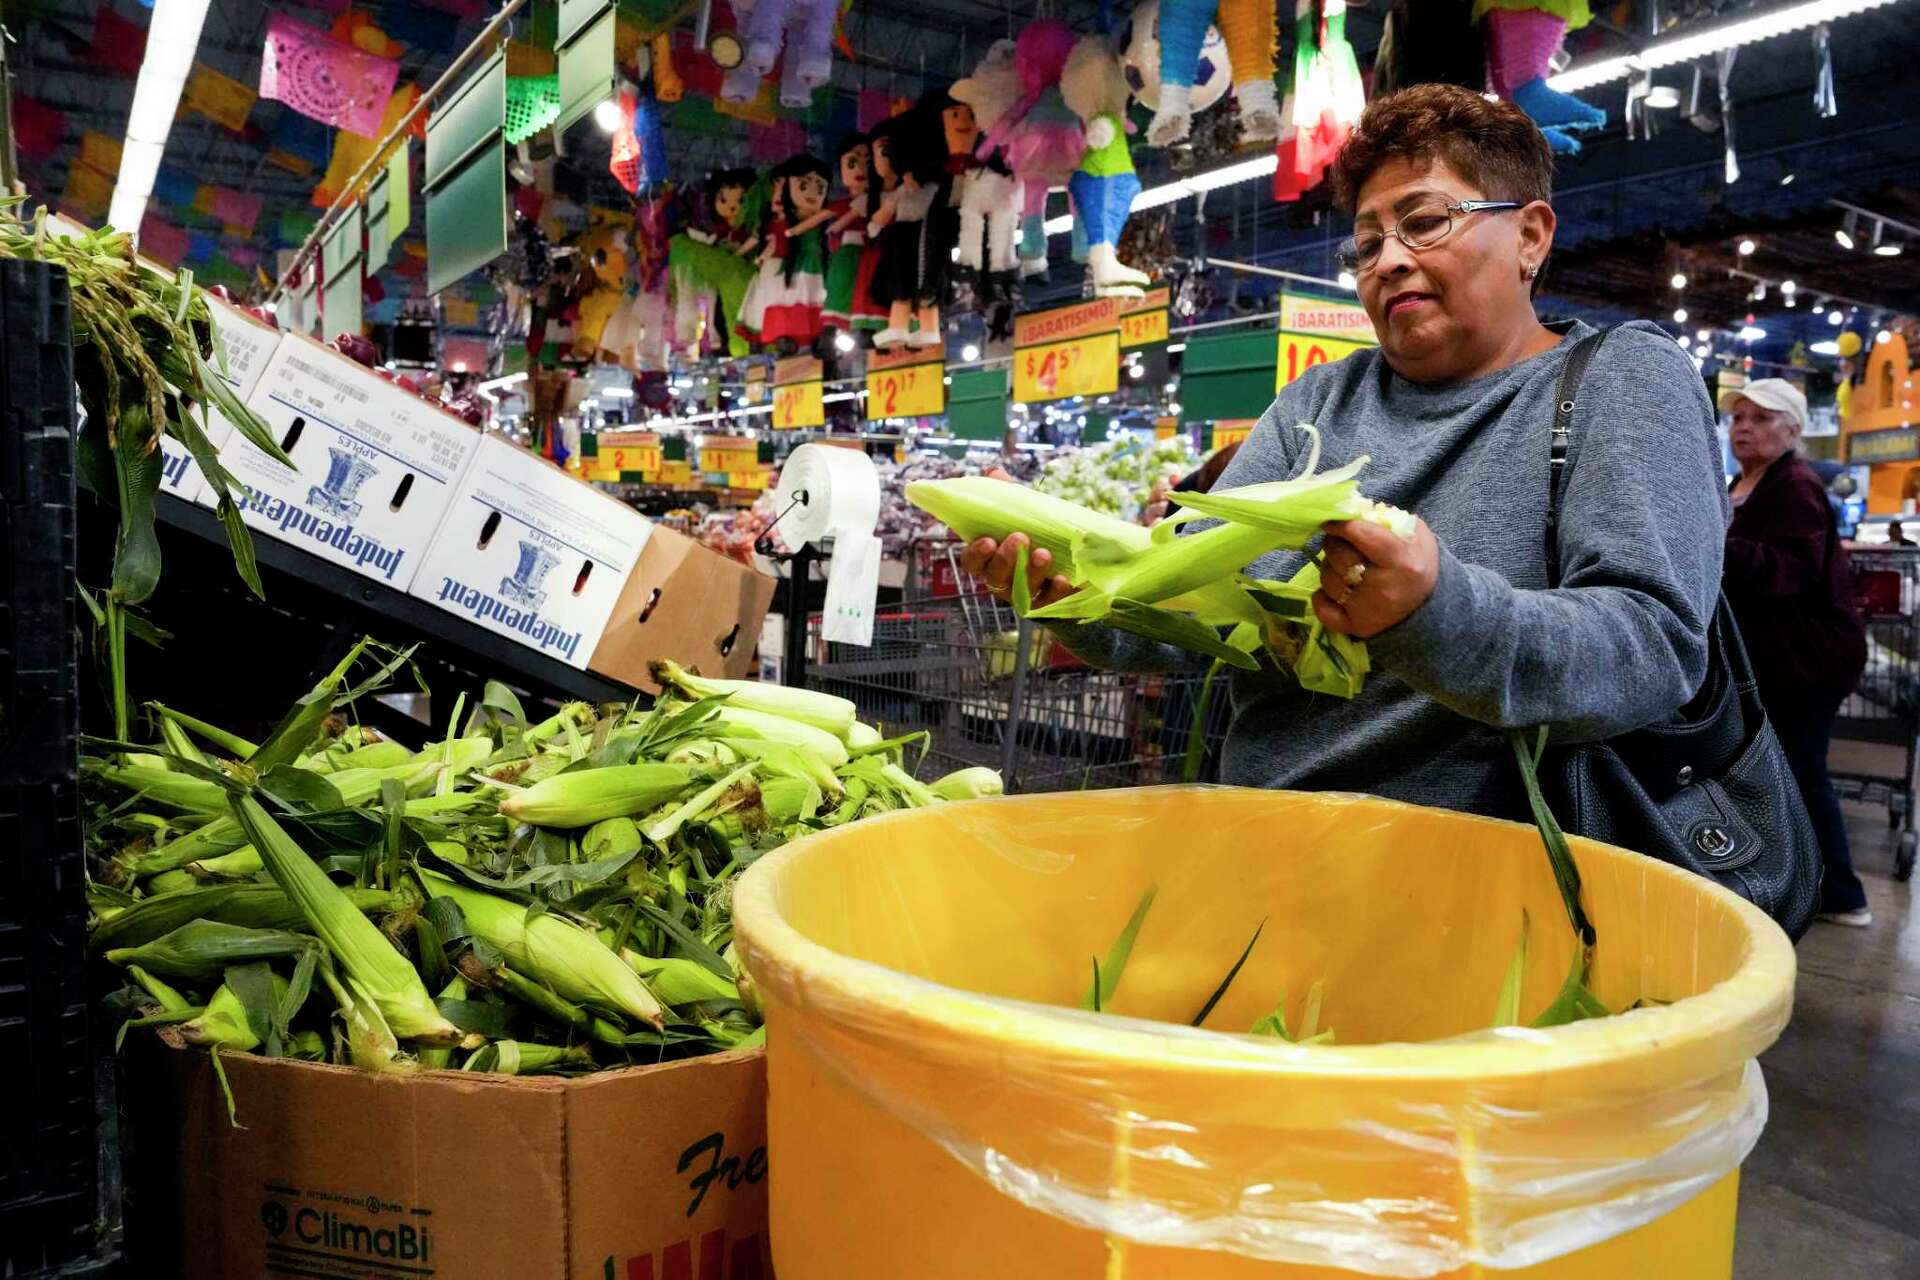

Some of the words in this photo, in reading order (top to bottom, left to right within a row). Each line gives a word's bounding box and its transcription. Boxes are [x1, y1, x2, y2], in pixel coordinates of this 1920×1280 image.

[337, 435, 378, 458] APPLES
[231, 483, 405, 581] Independent
[527, 529, 562, 550] APPLES
[437, 576, 585, 661] Independent
